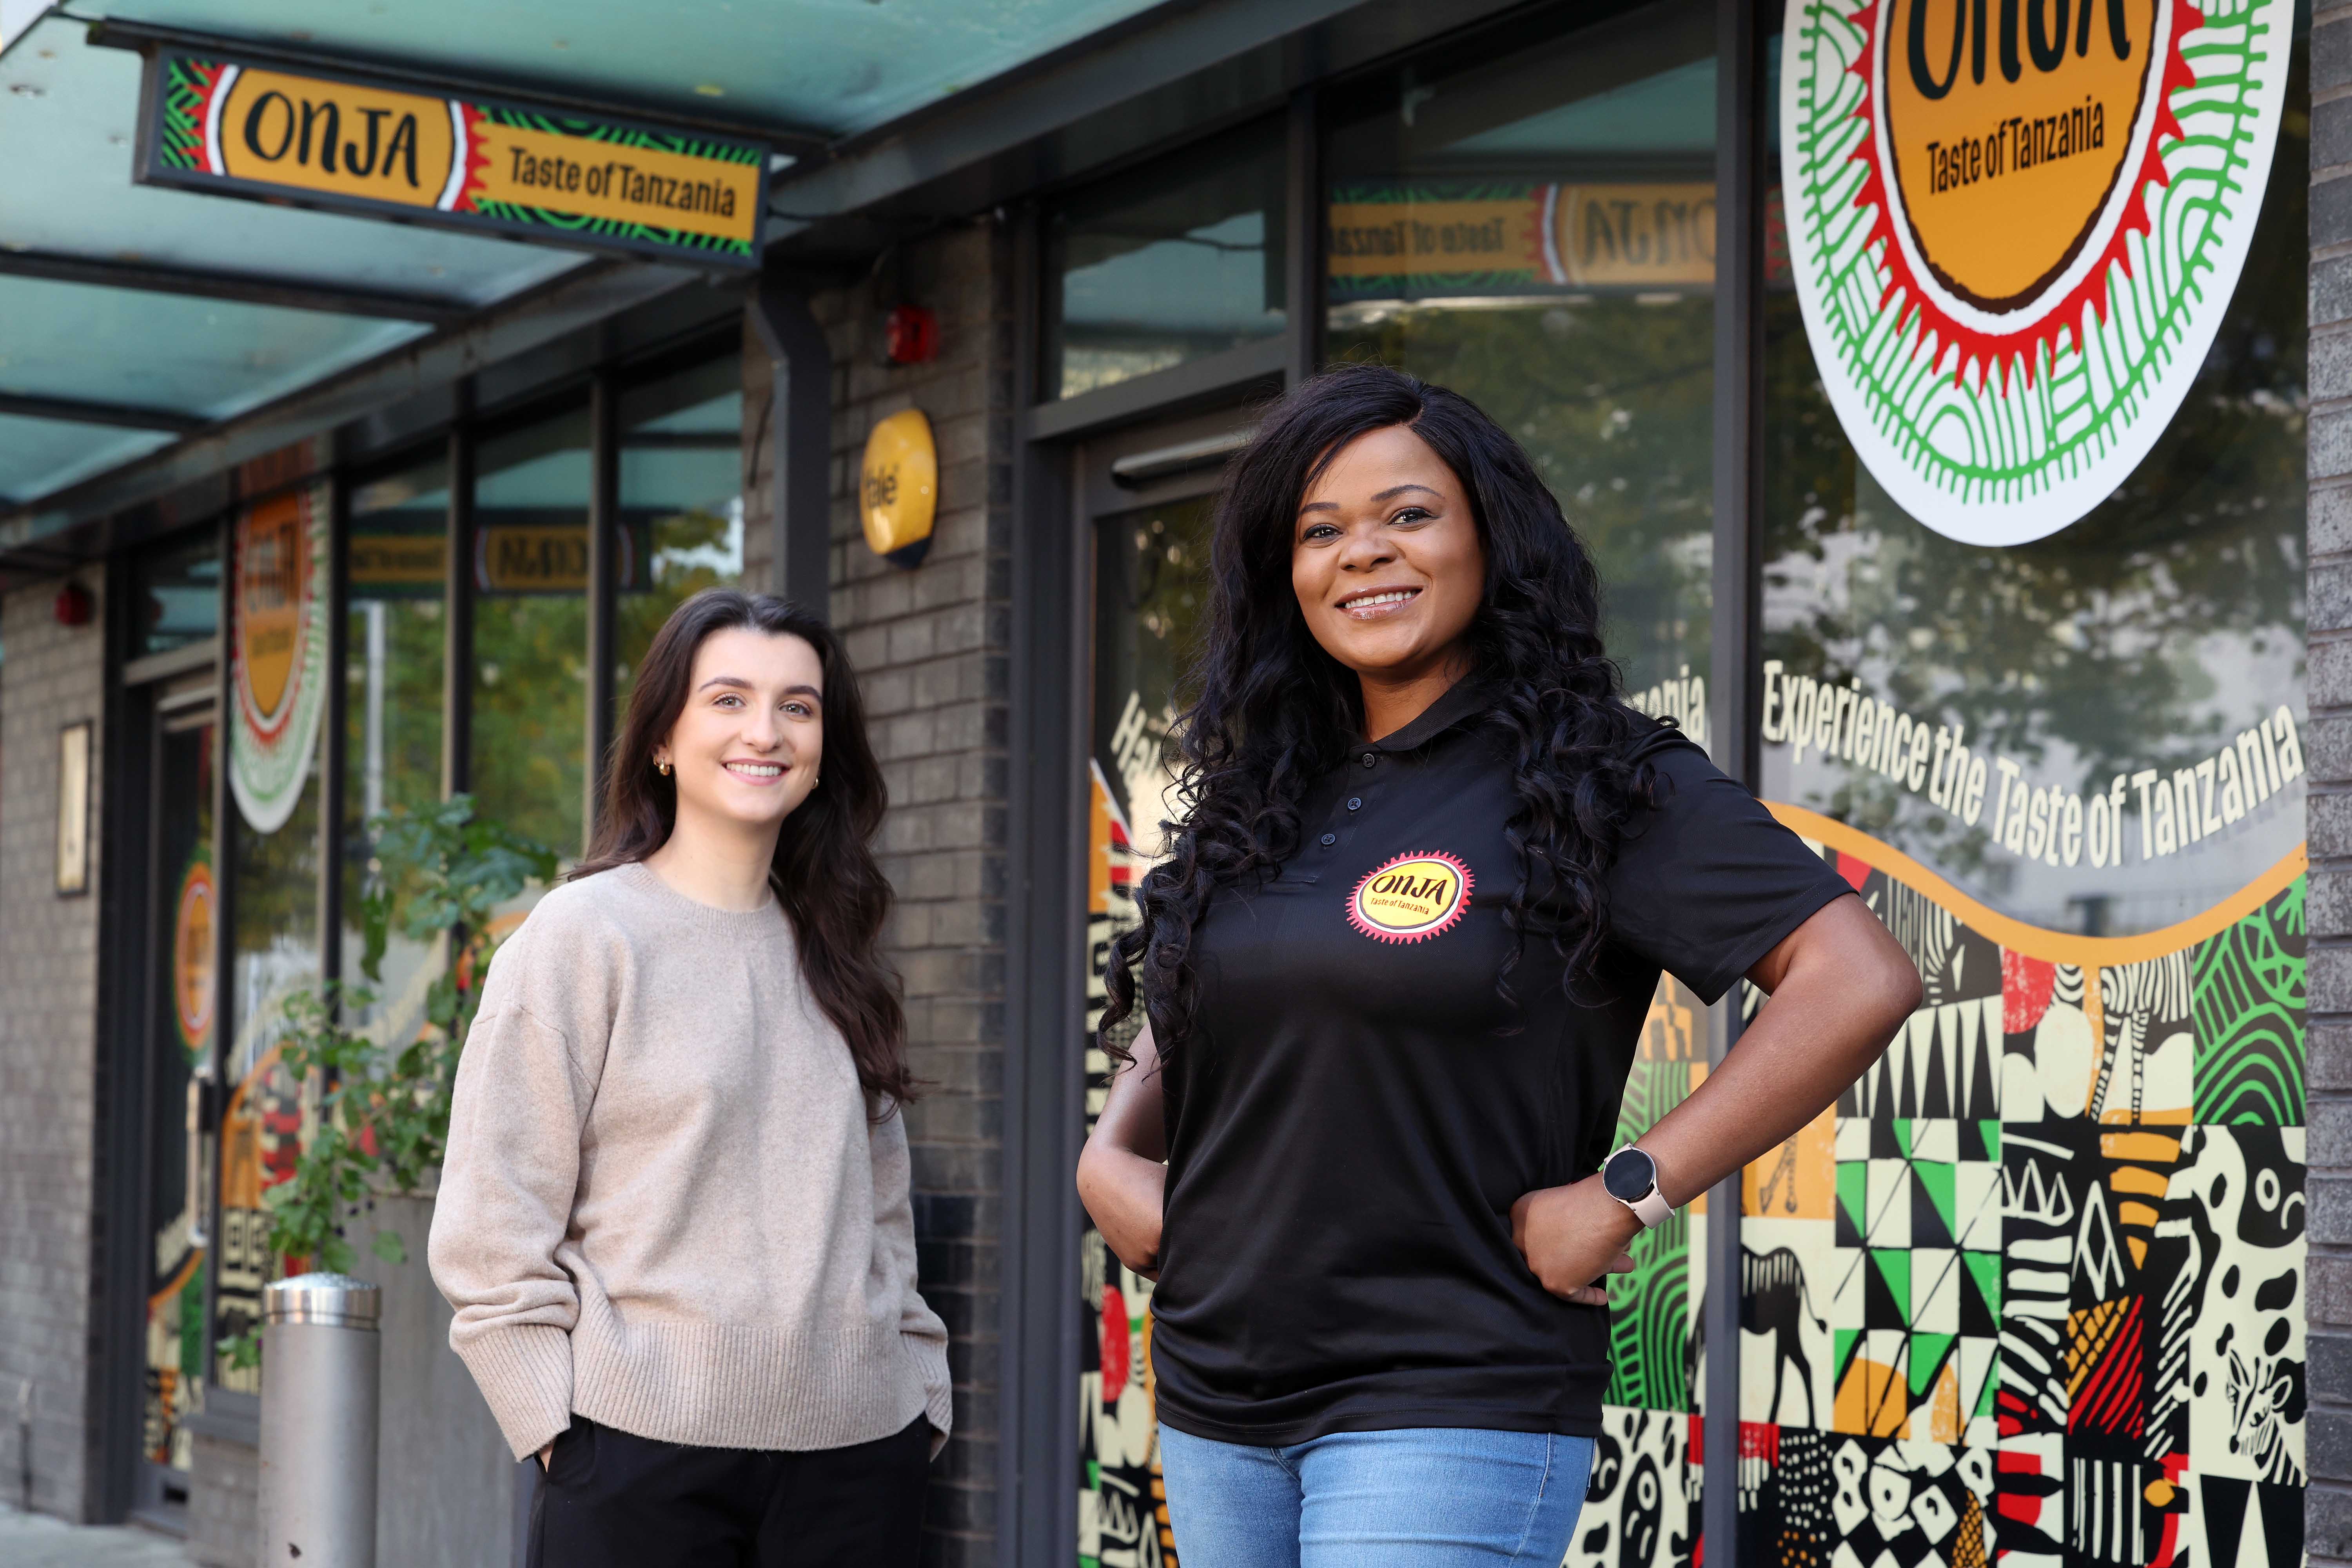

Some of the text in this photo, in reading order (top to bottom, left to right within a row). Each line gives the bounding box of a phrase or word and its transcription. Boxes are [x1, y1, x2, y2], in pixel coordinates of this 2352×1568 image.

[243, 91, 421, 188] ONJA
[510, 145, 736, 218] Taste of Tanzania
[1926, 94, 2104, 194] Taste of Tanzania
[1763, 660, 2305, 869] Experience the Taste of Tanzania
[1372, 875, 1447, 905] ONJA
[1398, 900, 1429, 915] Tanzania
